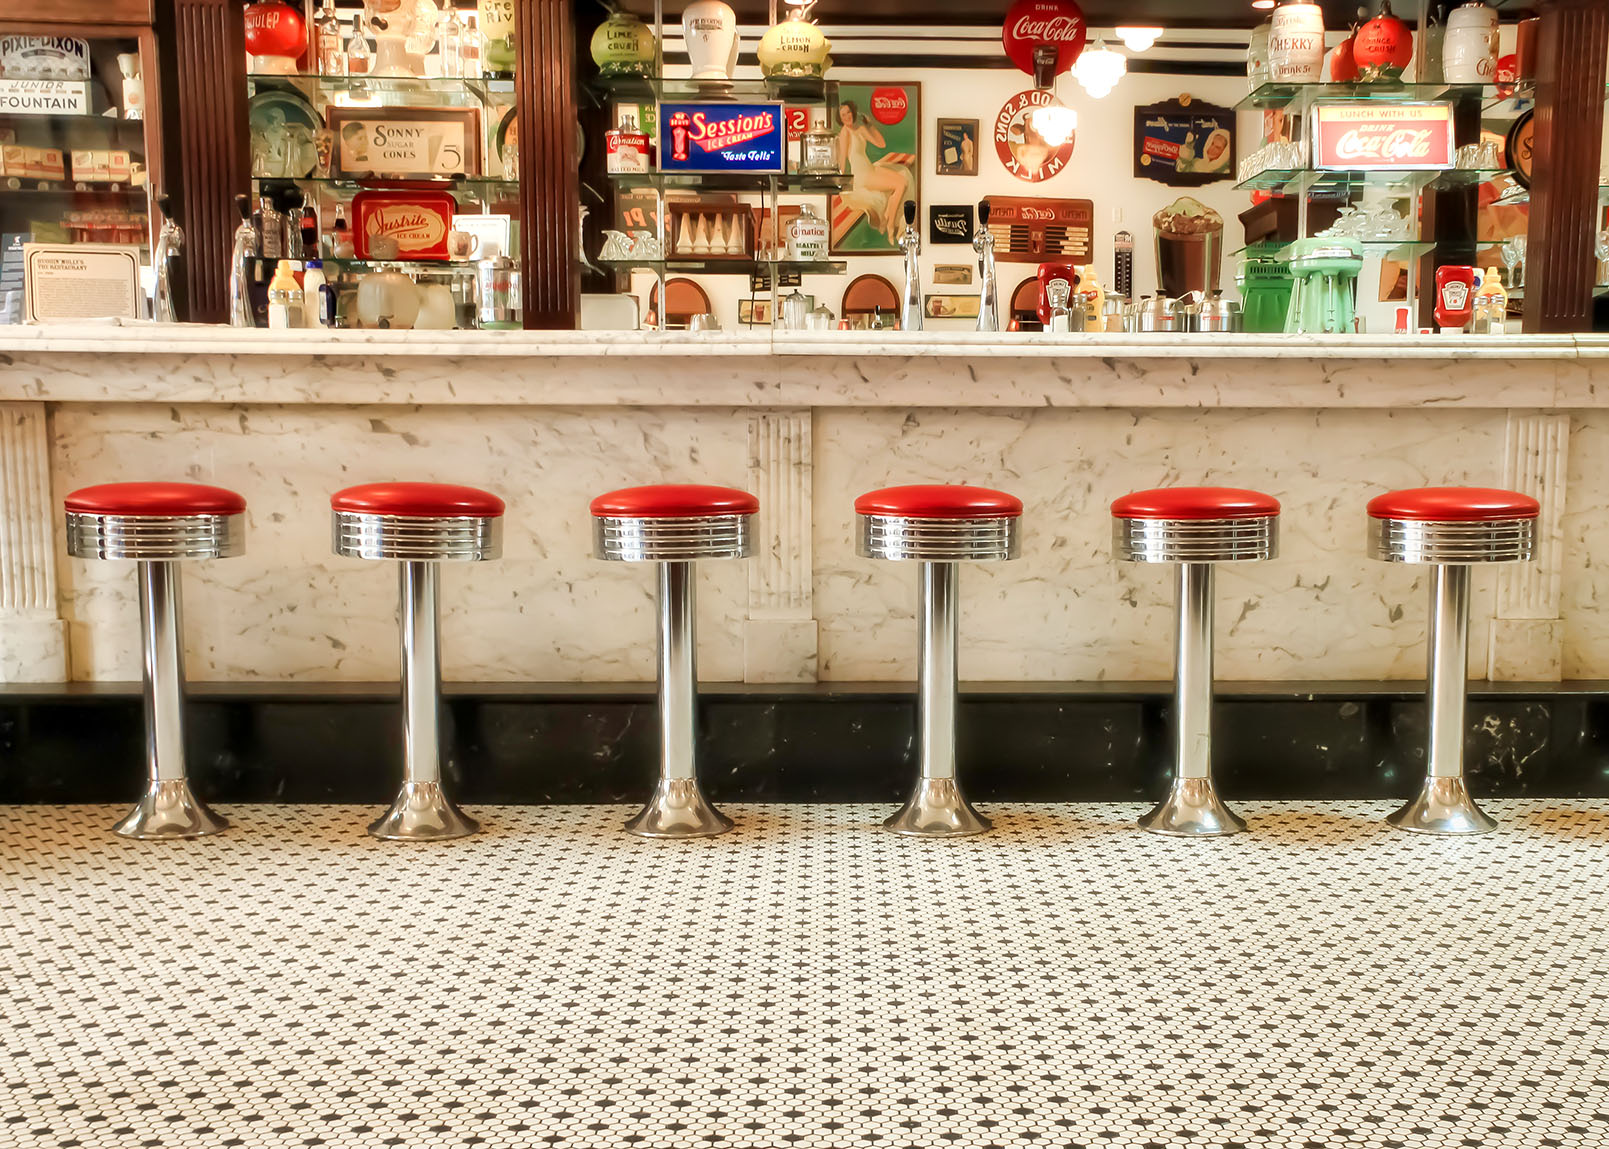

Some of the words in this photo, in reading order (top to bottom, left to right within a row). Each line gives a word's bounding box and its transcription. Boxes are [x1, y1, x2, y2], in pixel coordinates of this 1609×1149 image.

[1035, 4, 1059, 12] DRINK
[1012, 15, 1081, 41] Coca-Cola
[607, 39, 639, 52] CRUSH
[1270, 37, 1314, 52] CHERRY
[1278, 64, 1302, 75] Drink
[10, 81, 64, 89] JUNIOR
[0, 96, 78, 109] FOUNTAIN
[1340, 111, 1375, 119] LUNCH
[1379, 111, 1405, 119] WITH
[1409, 110, 1424, 118] US
[687, 111, 773, 140] Session's
[1359, 124, 1396, 133] DRINK
[707, 138, 724, 151] ICE
[726, 132, 753, 145] CREAM
[1335, 128, 1433, 159] Coca-Cola
[383, 151, 416, 159] CONES
[375, 208, 430, 236] Justrite
[791, 225, 825, 239] Canation
